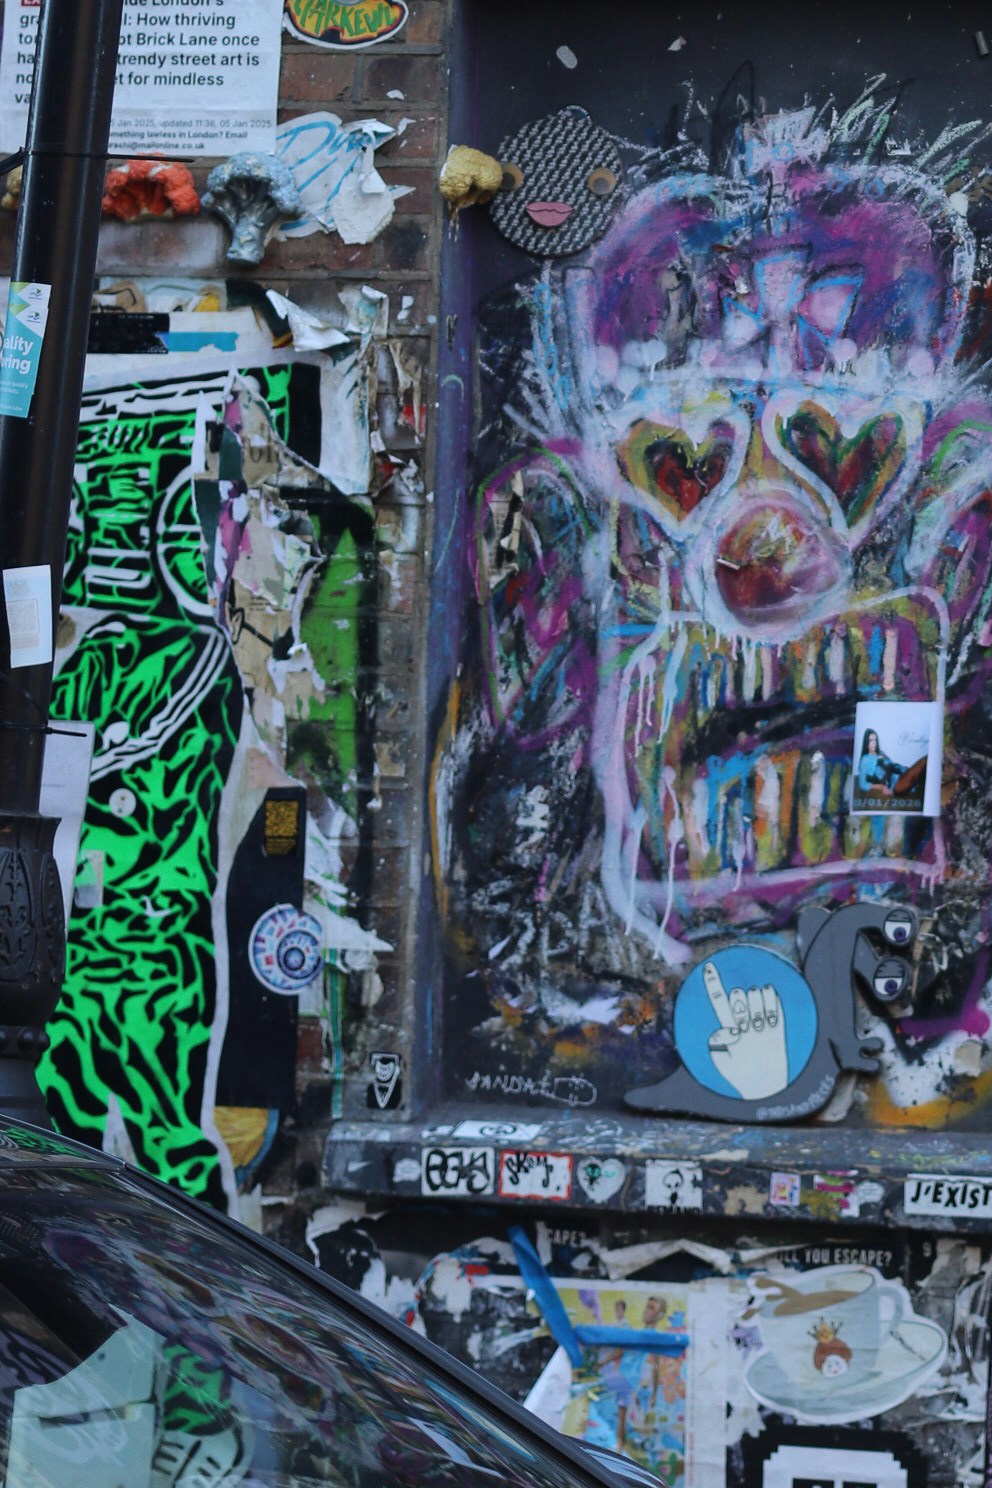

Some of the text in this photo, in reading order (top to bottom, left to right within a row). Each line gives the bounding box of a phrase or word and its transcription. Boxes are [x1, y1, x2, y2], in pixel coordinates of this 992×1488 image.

[136, 14, 170, 27] How
[175, 13, 236, 30] thriving
[136, 33, 175, 46] Brick
[179, 33, 217, 46] Lane
[221, 35, 260, 46] once
[118, 53, 260, 69] trendy street art is
[127, 71, 150, 85] for
[153, 71, 224, 85] mindless
[804, 1248, 831, 1263] YOU
[833, 1249, 893, 1267] ESCAPE?
